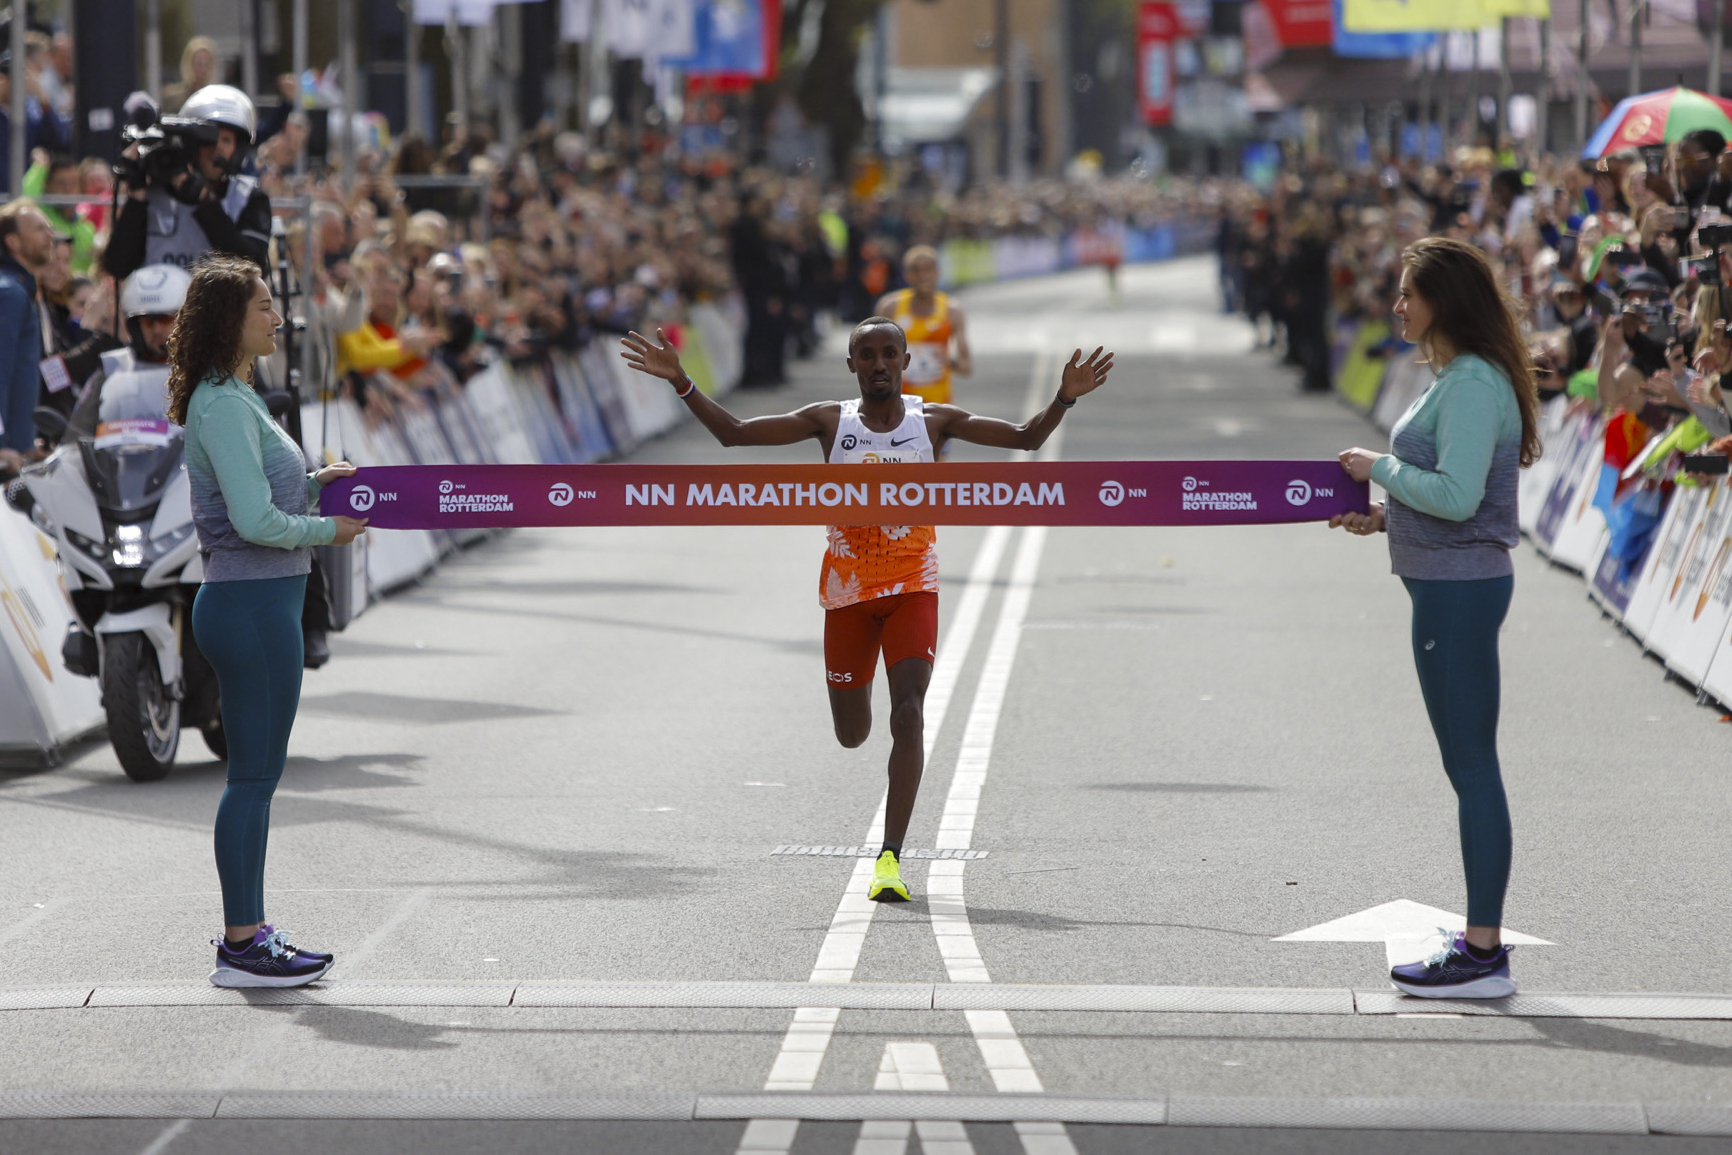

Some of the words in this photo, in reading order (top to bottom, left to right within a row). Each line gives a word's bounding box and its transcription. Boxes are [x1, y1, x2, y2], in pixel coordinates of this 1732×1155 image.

[859, 438, 872, 446] NN
[379, 492, 397, 502] NN
[577, 490, 597, 499] NN
[625, 483, 675, 506] NN
[686, 482, 868, 507] MARATHON
[880, 482, 1066, 507] ROTTERDAM
[1128, 488, 1147, 498] NN
[1182, 492, 1253, 502] MARATHON
[1315, 487, 1334, 498] NN
[439, 494, 508, 503] MARATHON
[439, 503, 514, 513] ROTTERDAM
[1182, 501, 1258, 511] ROTTERDAM
[827, 671, 853, 683] EOS
